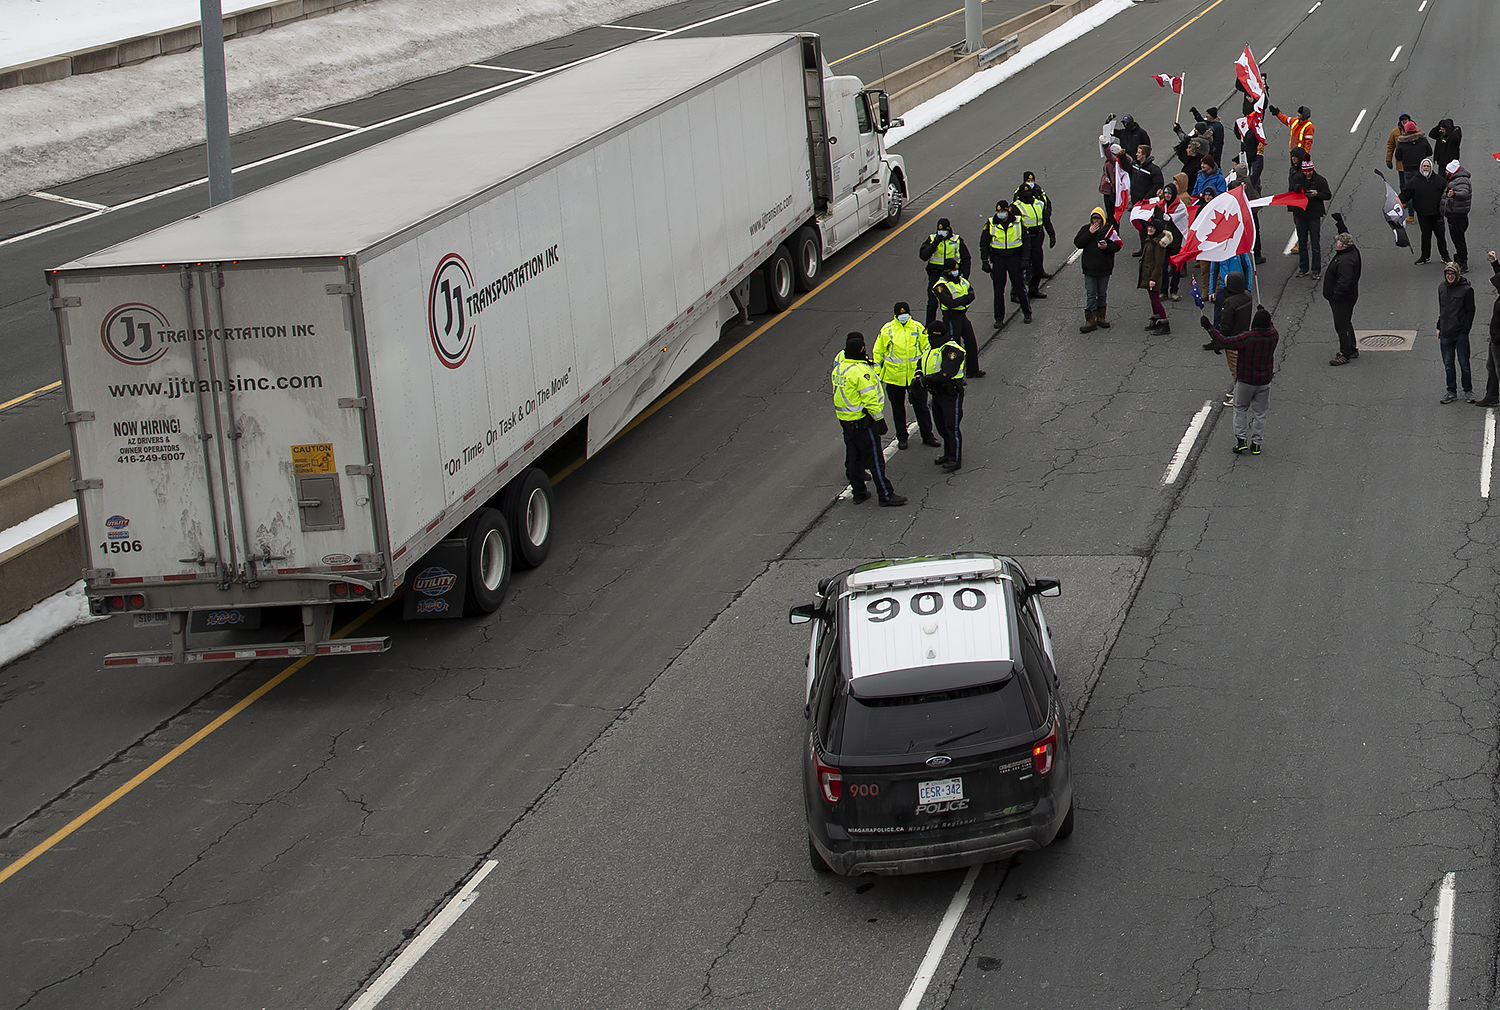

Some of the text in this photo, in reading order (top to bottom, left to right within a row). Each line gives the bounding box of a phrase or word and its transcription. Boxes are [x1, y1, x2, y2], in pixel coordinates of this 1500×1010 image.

[749, 194, 793, 236] www.jjtransinc.com
[466, 243, 560, 318] TRANSPORTATION INC
[440, 278, 465, 342] JJ
[119, 316, 153, 354] JJ
[292, 324, 316, 337] INC
[107, 373, 323, 399] www.jjtransinc.com
[113, 418, 181, 437] NOW HIRING!
[444, 366, 572, 477] "On Time, On Task & On The Move"
[127, 437, 137, 445] AZ
[137, 436, 164, 445] DRIVERS
[293, 444, 331, 453] CAUTION
[119, 444, 180, 455] OWNER OPERATORS
[117, 452, 185, 464] 416-249-6007
[99, 540, 143, 554] 1506
[416, 576, 454, 589] UTILITY
[866, 587, 987, 623] 900
[850, 784, 879, 797] 900
[920, 785, 941, 799] CESR
[945, 783, 961, 796] 342
[915, 798, 970, 816] POLICE
[908, 823, 938, 832] Niagara
[941, 818, 977, 828] Regional
